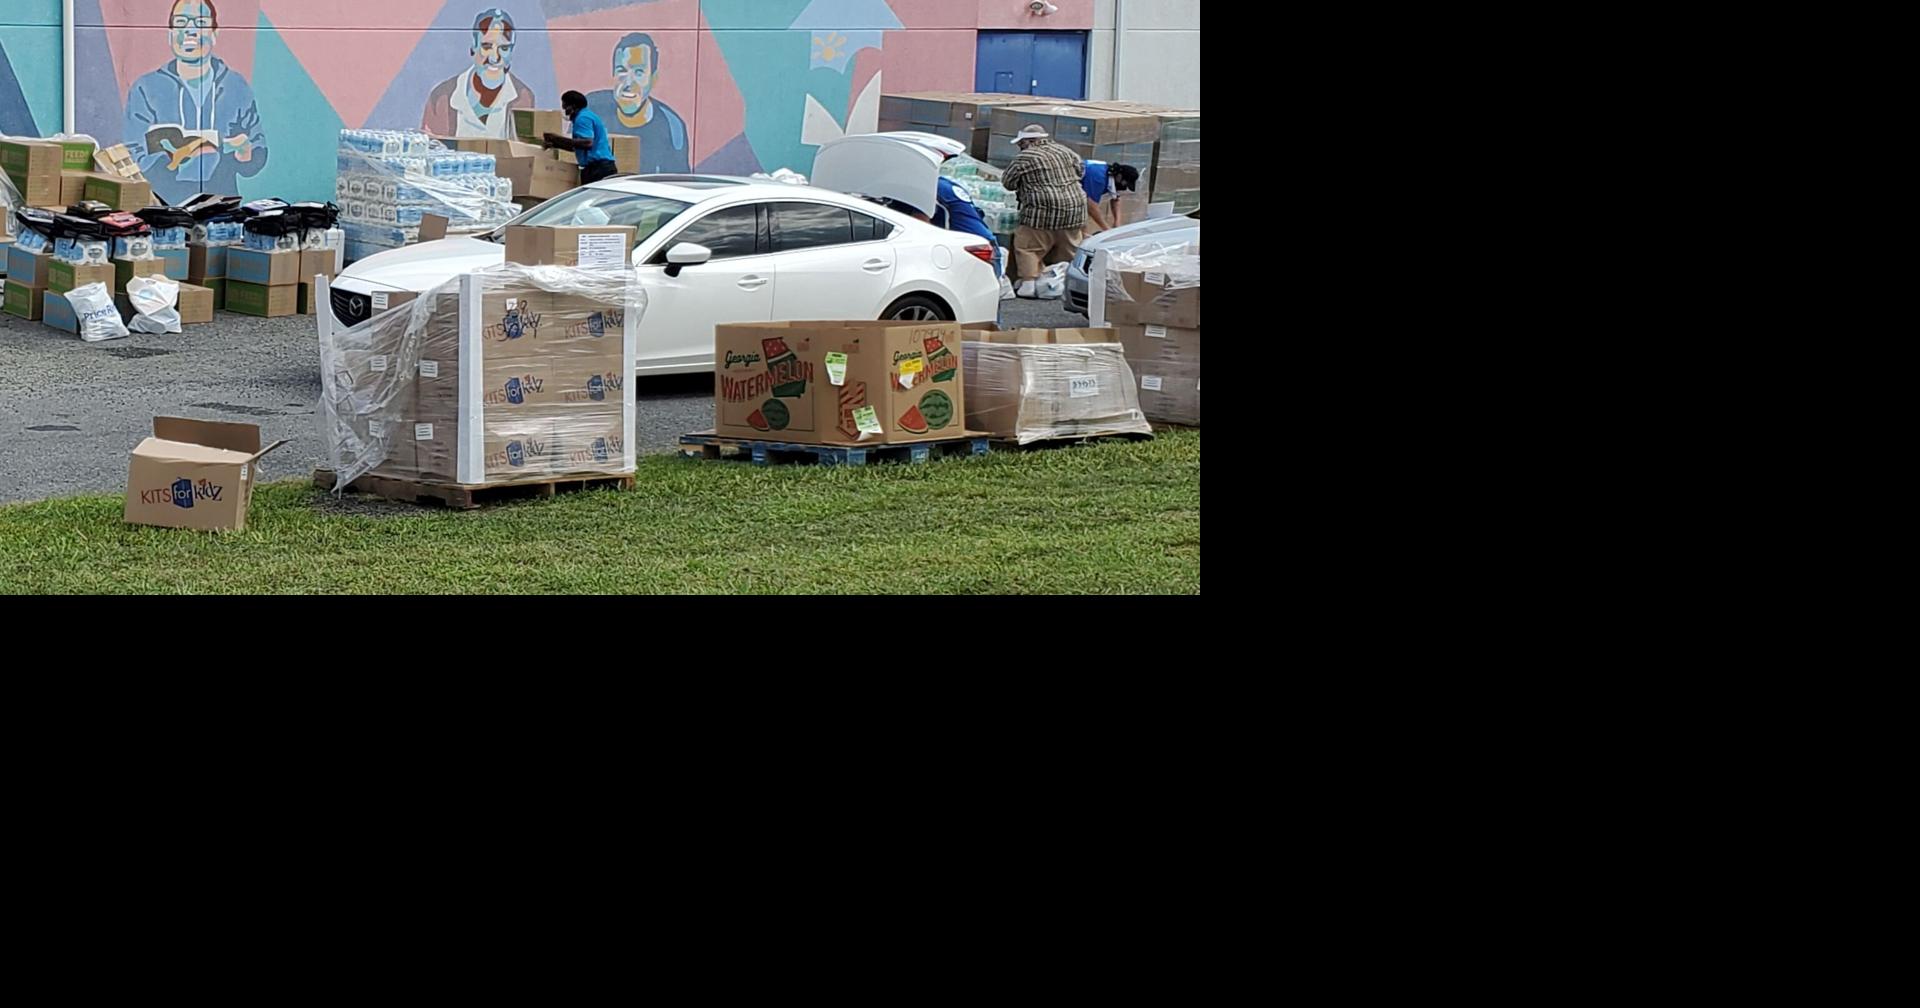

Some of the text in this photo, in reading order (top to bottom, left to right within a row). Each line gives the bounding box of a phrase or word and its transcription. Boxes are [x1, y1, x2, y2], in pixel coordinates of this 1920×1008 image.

[725, 350, 760, 369] Georgia
[720, 361, 814, 403] WATERMELON
[141, 478, 223, 504] KITS for kidz
